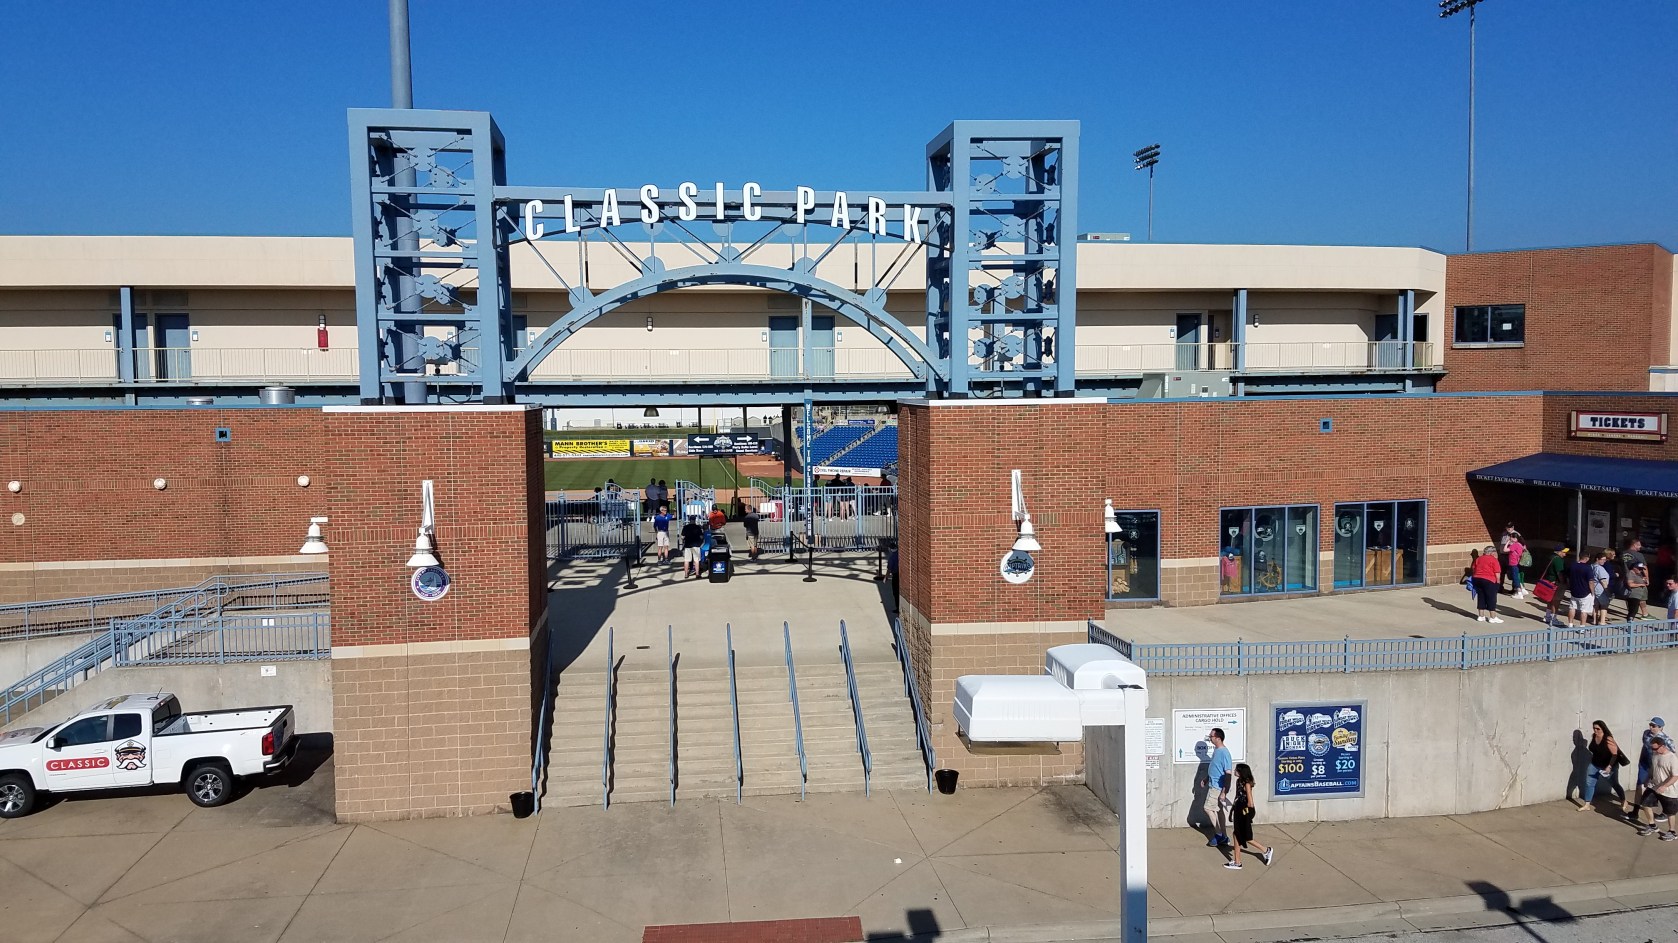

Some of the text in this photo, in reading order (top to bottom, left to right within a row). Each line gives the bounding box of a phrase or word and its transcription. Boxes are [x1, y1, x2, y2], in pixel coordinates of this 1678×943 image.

[524, 181, 922, 245] CLASSIC PARK
[1590, 416, 1646, 429] TICKETS
[1334, 737, 1356, 746] Sunday
[50, 758, 105, 770] CLASSIC
[1278, 764, 1304, 774] $100
[1336, 760, 1356, 770] $20
[1312, 765, 1325, 776] $8
